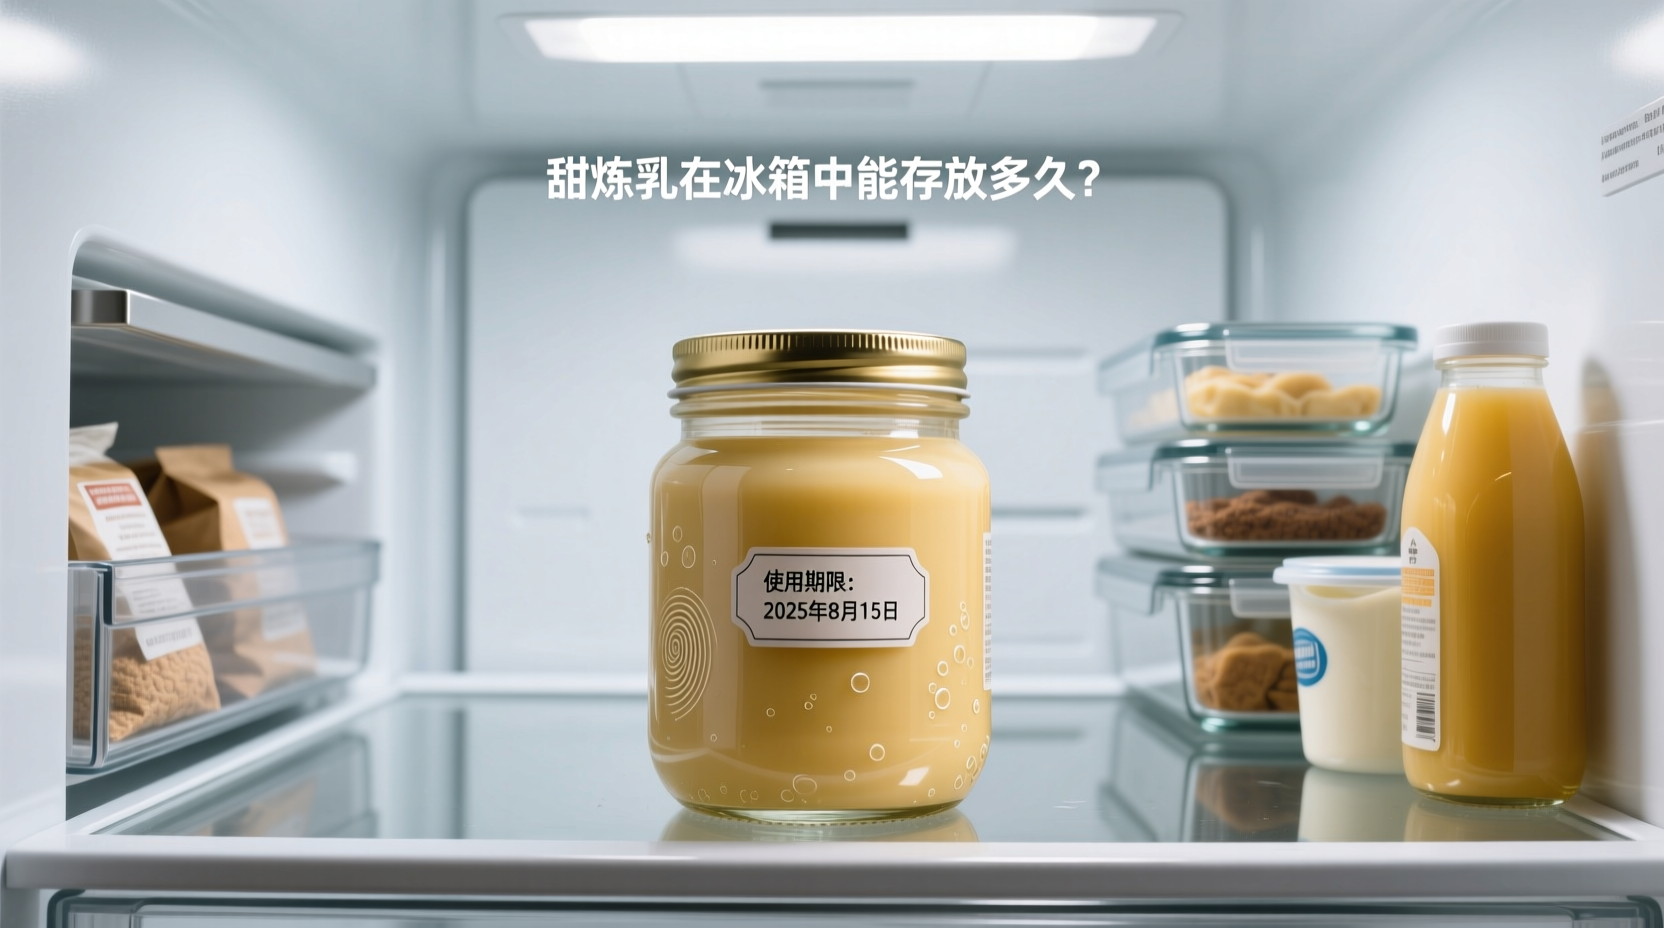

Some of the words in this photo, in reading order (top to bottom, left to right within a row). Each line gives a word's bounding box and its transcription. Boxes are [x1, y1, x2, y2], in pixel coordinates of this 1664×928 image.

[763, 568, 854, 593] 使用期限：
[763, 600, 898, 622] 2025年8月15日
